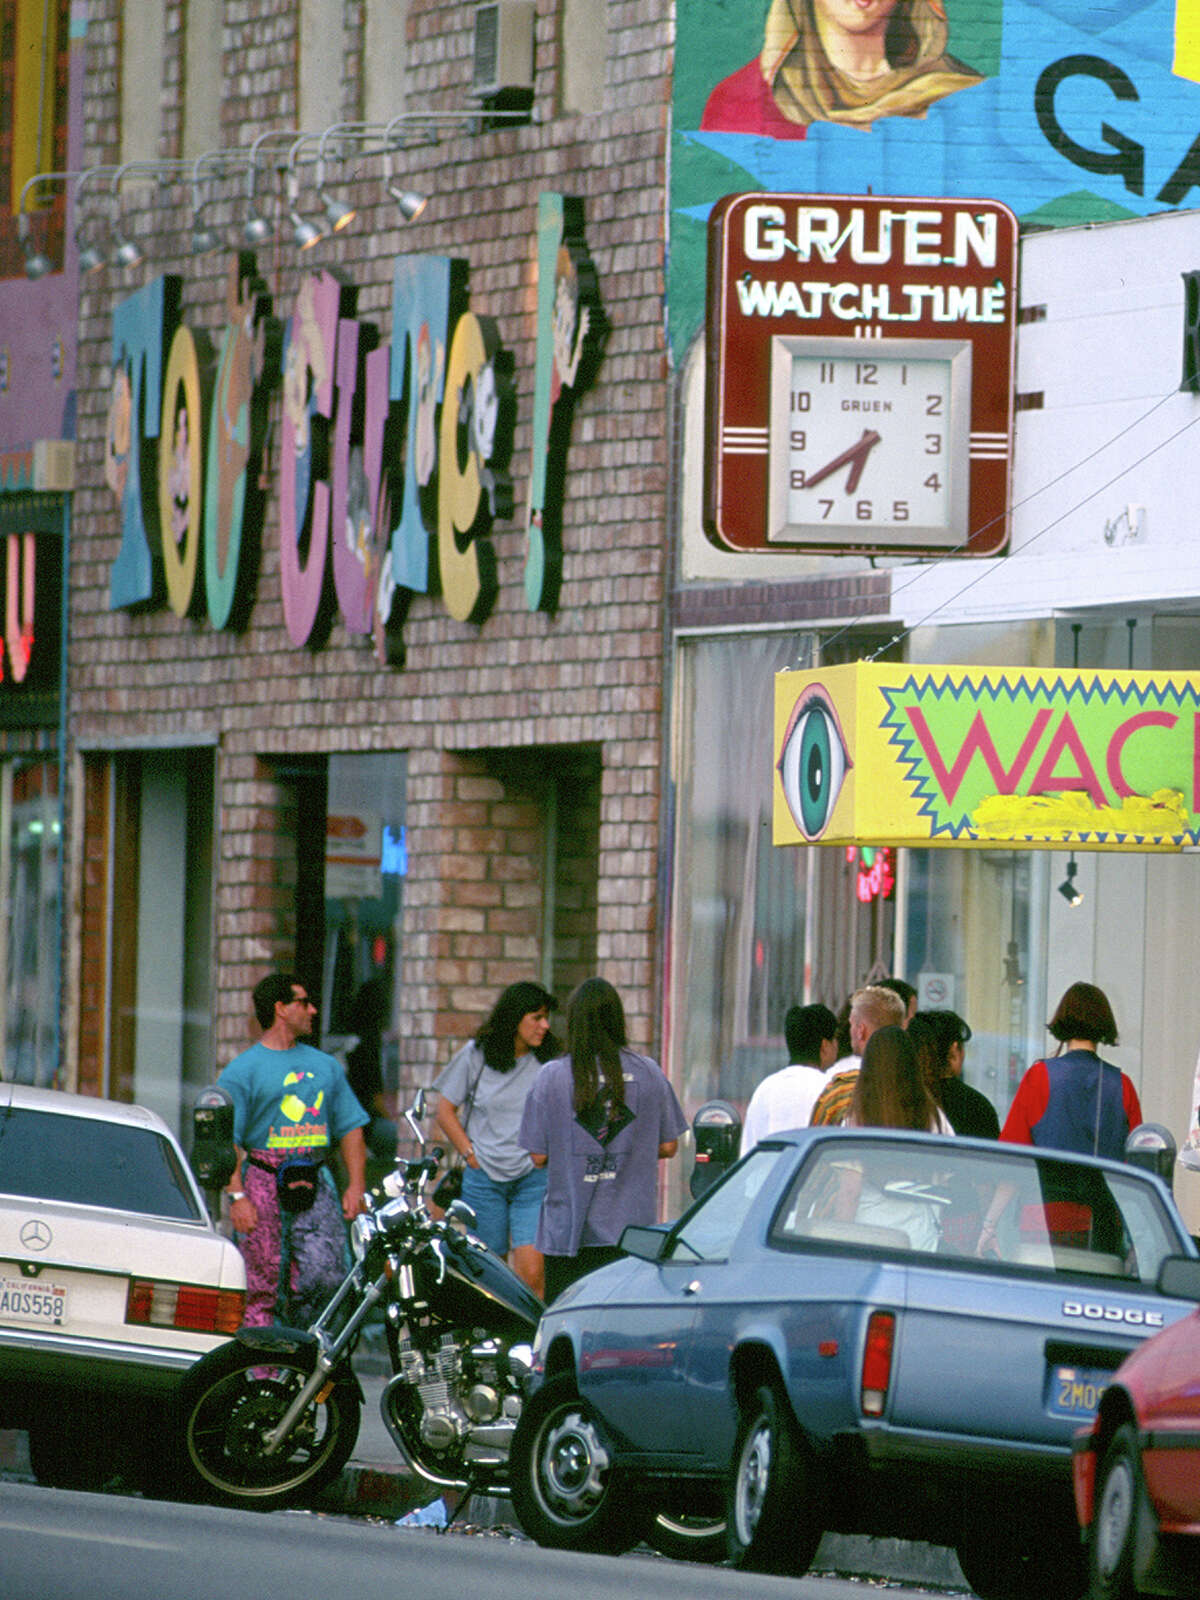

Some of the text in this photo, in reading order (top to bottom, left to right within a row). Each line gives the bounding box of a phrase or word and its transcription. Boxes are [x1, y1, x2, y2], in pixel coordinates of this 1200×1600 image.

[744, 205, 998, 268] GRUEN
[736, 279, 1006, 324] WATCH TIME
[855, 363, 879, 385] 12
[790, 392, 811, 412] 10
[841, 399, 893, 412] GRUEN
[926, 396, 943, 416] 2
[790, 430, 806, 450] 9
[925, 434, 942, 455] 3
[790, 470, 805, 490] 8
[924, 473, 942, 492] 4
[818, 500, 910, 521] 7 6 5
[1063, 1301, 1164, 1328] DODGE
